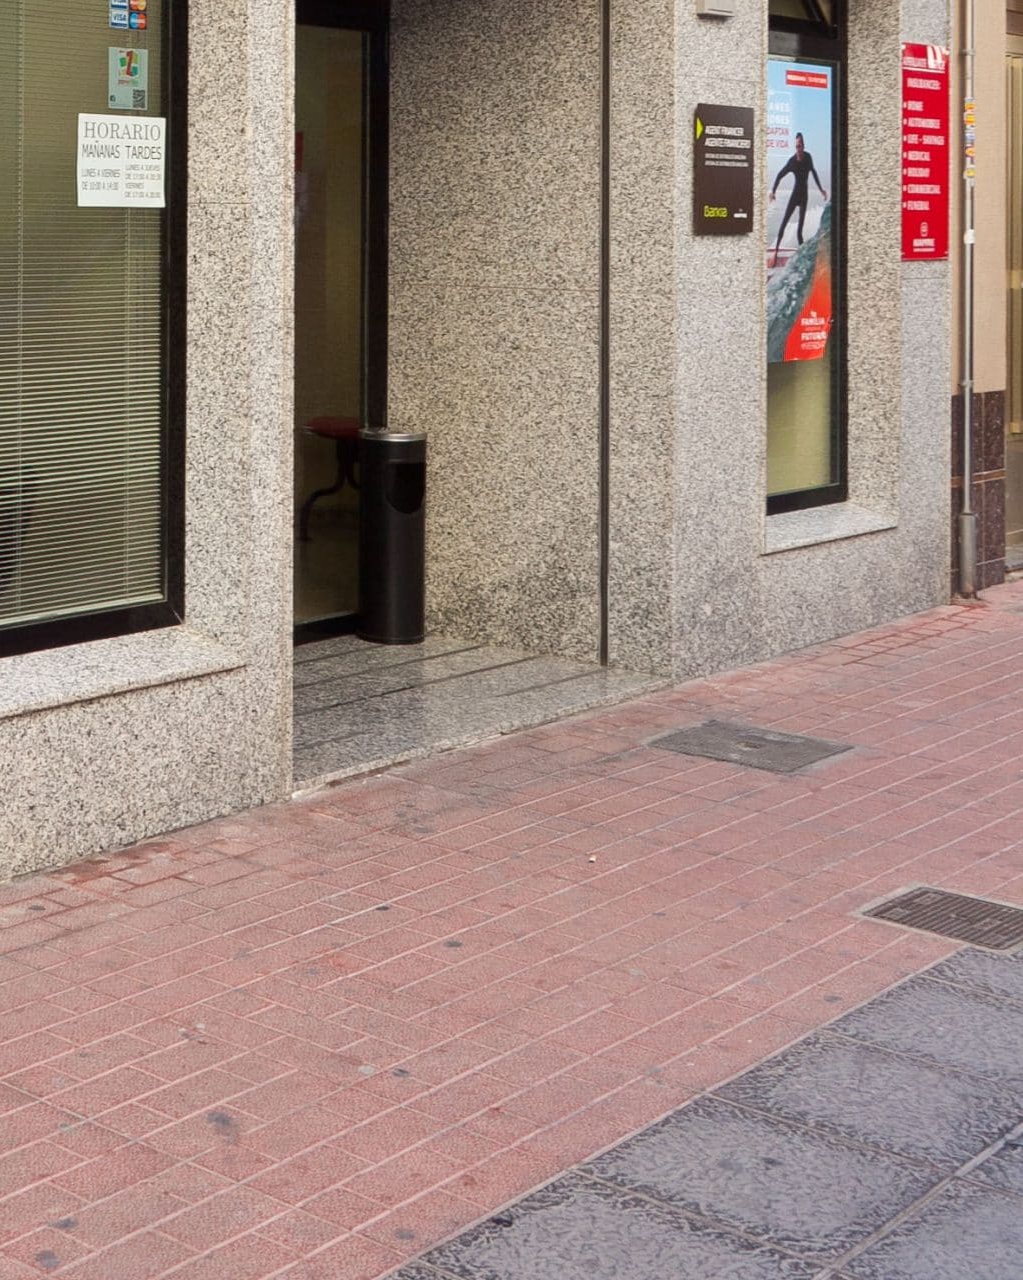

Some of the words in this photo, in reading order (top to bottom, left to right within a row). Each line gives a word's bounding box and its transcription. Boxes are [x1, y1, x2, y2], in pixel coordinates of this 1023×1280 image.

[113, 13, 127, 21] VISA
[83, 120, 161, 141] HORARIO
[81, 140, 121, 159] MAÑANAS
[125, 145, 162, 160] TARDES
